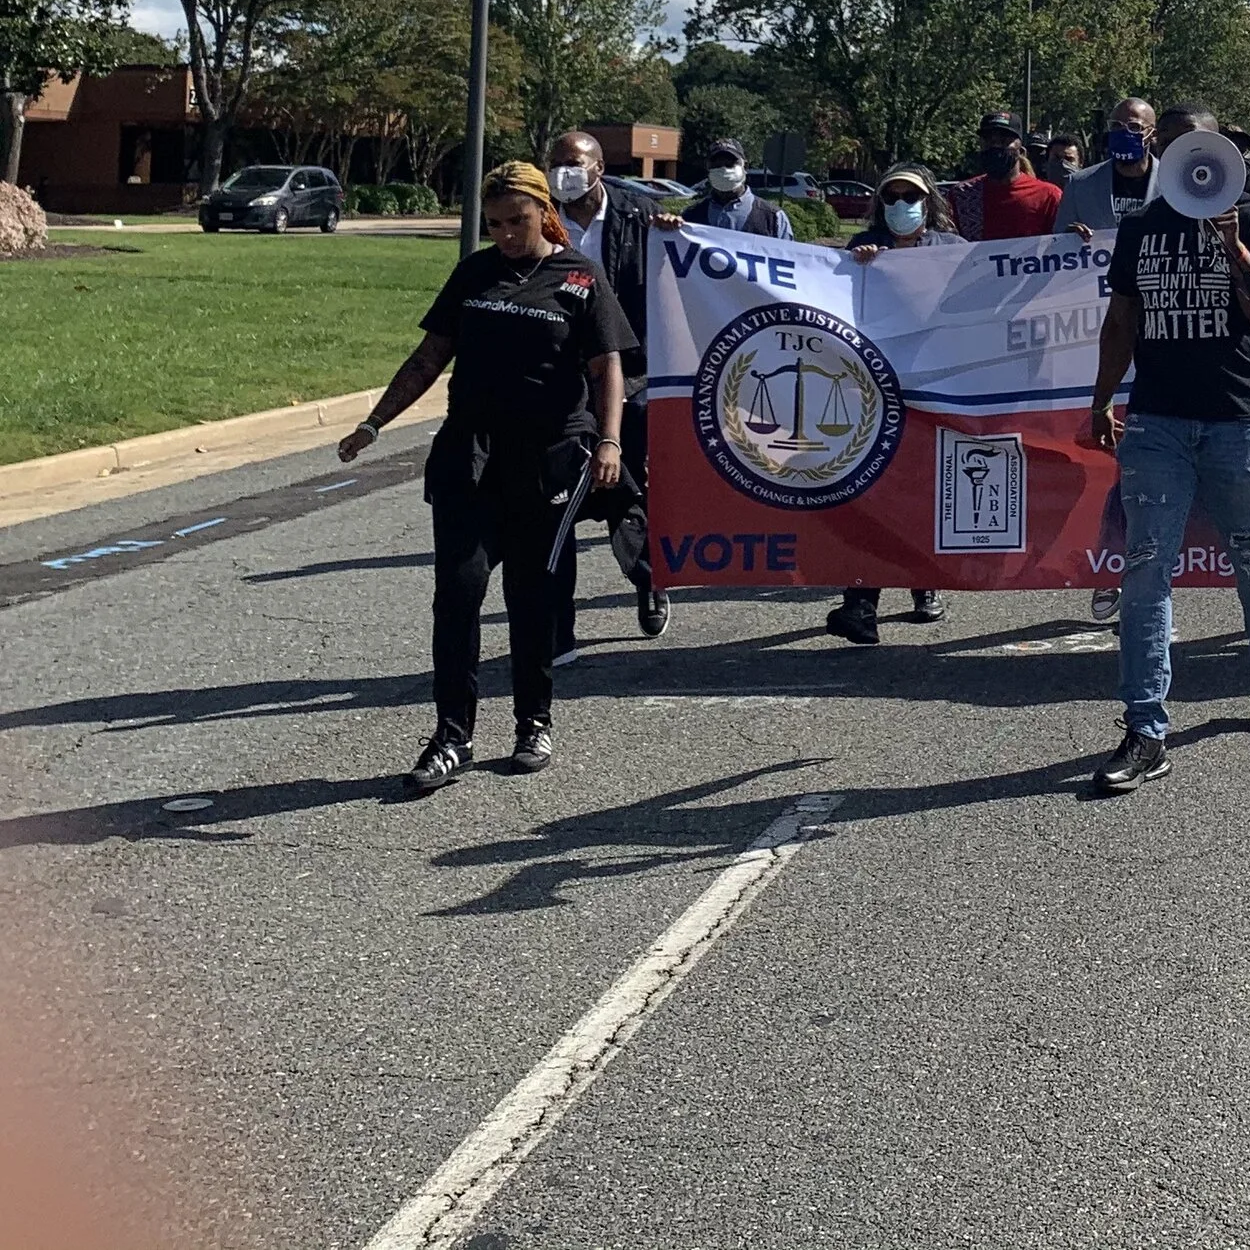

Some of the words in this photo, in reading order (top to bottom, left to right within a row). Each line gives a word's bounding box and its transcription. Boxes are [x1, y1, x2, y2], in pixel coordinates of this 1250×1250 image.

[989, 244, 1113, 277] Transfo
[1138, 233, 1169, 258] ALL
[662, 240, 797, 290] VOTE
[1137, 256, 1172, 274] CAN'T
[1160, 273, 1200, 290] UNTIL
[1186, 290, 1231, 308] LIVES
[1006, 306, 1103, 352] EDMU
[1144, 308, 1231, 340] MATTER
[775, 331, 824, 354] TJC
[699, 307, 791, 435] TRANSFORMATIVE
[795, 308, 864, 349] JUSTICE
[715, 451, 752, 490] IGNITING
[752, 484, 795, 505] CHANGE
[796, 495, 806, 506] &
[806, 485, 855, 506] INSPIRING
[854, 453, 886, 487] ACTION
[944, 453, 953, 500] NATIONAL
[1009, 454, 1018, 518] ASSOCIATION
[944, 501, 953, 521] THE
[659, 533, 797, 575] VOTE
[971, 535, 990, 543] 1925
